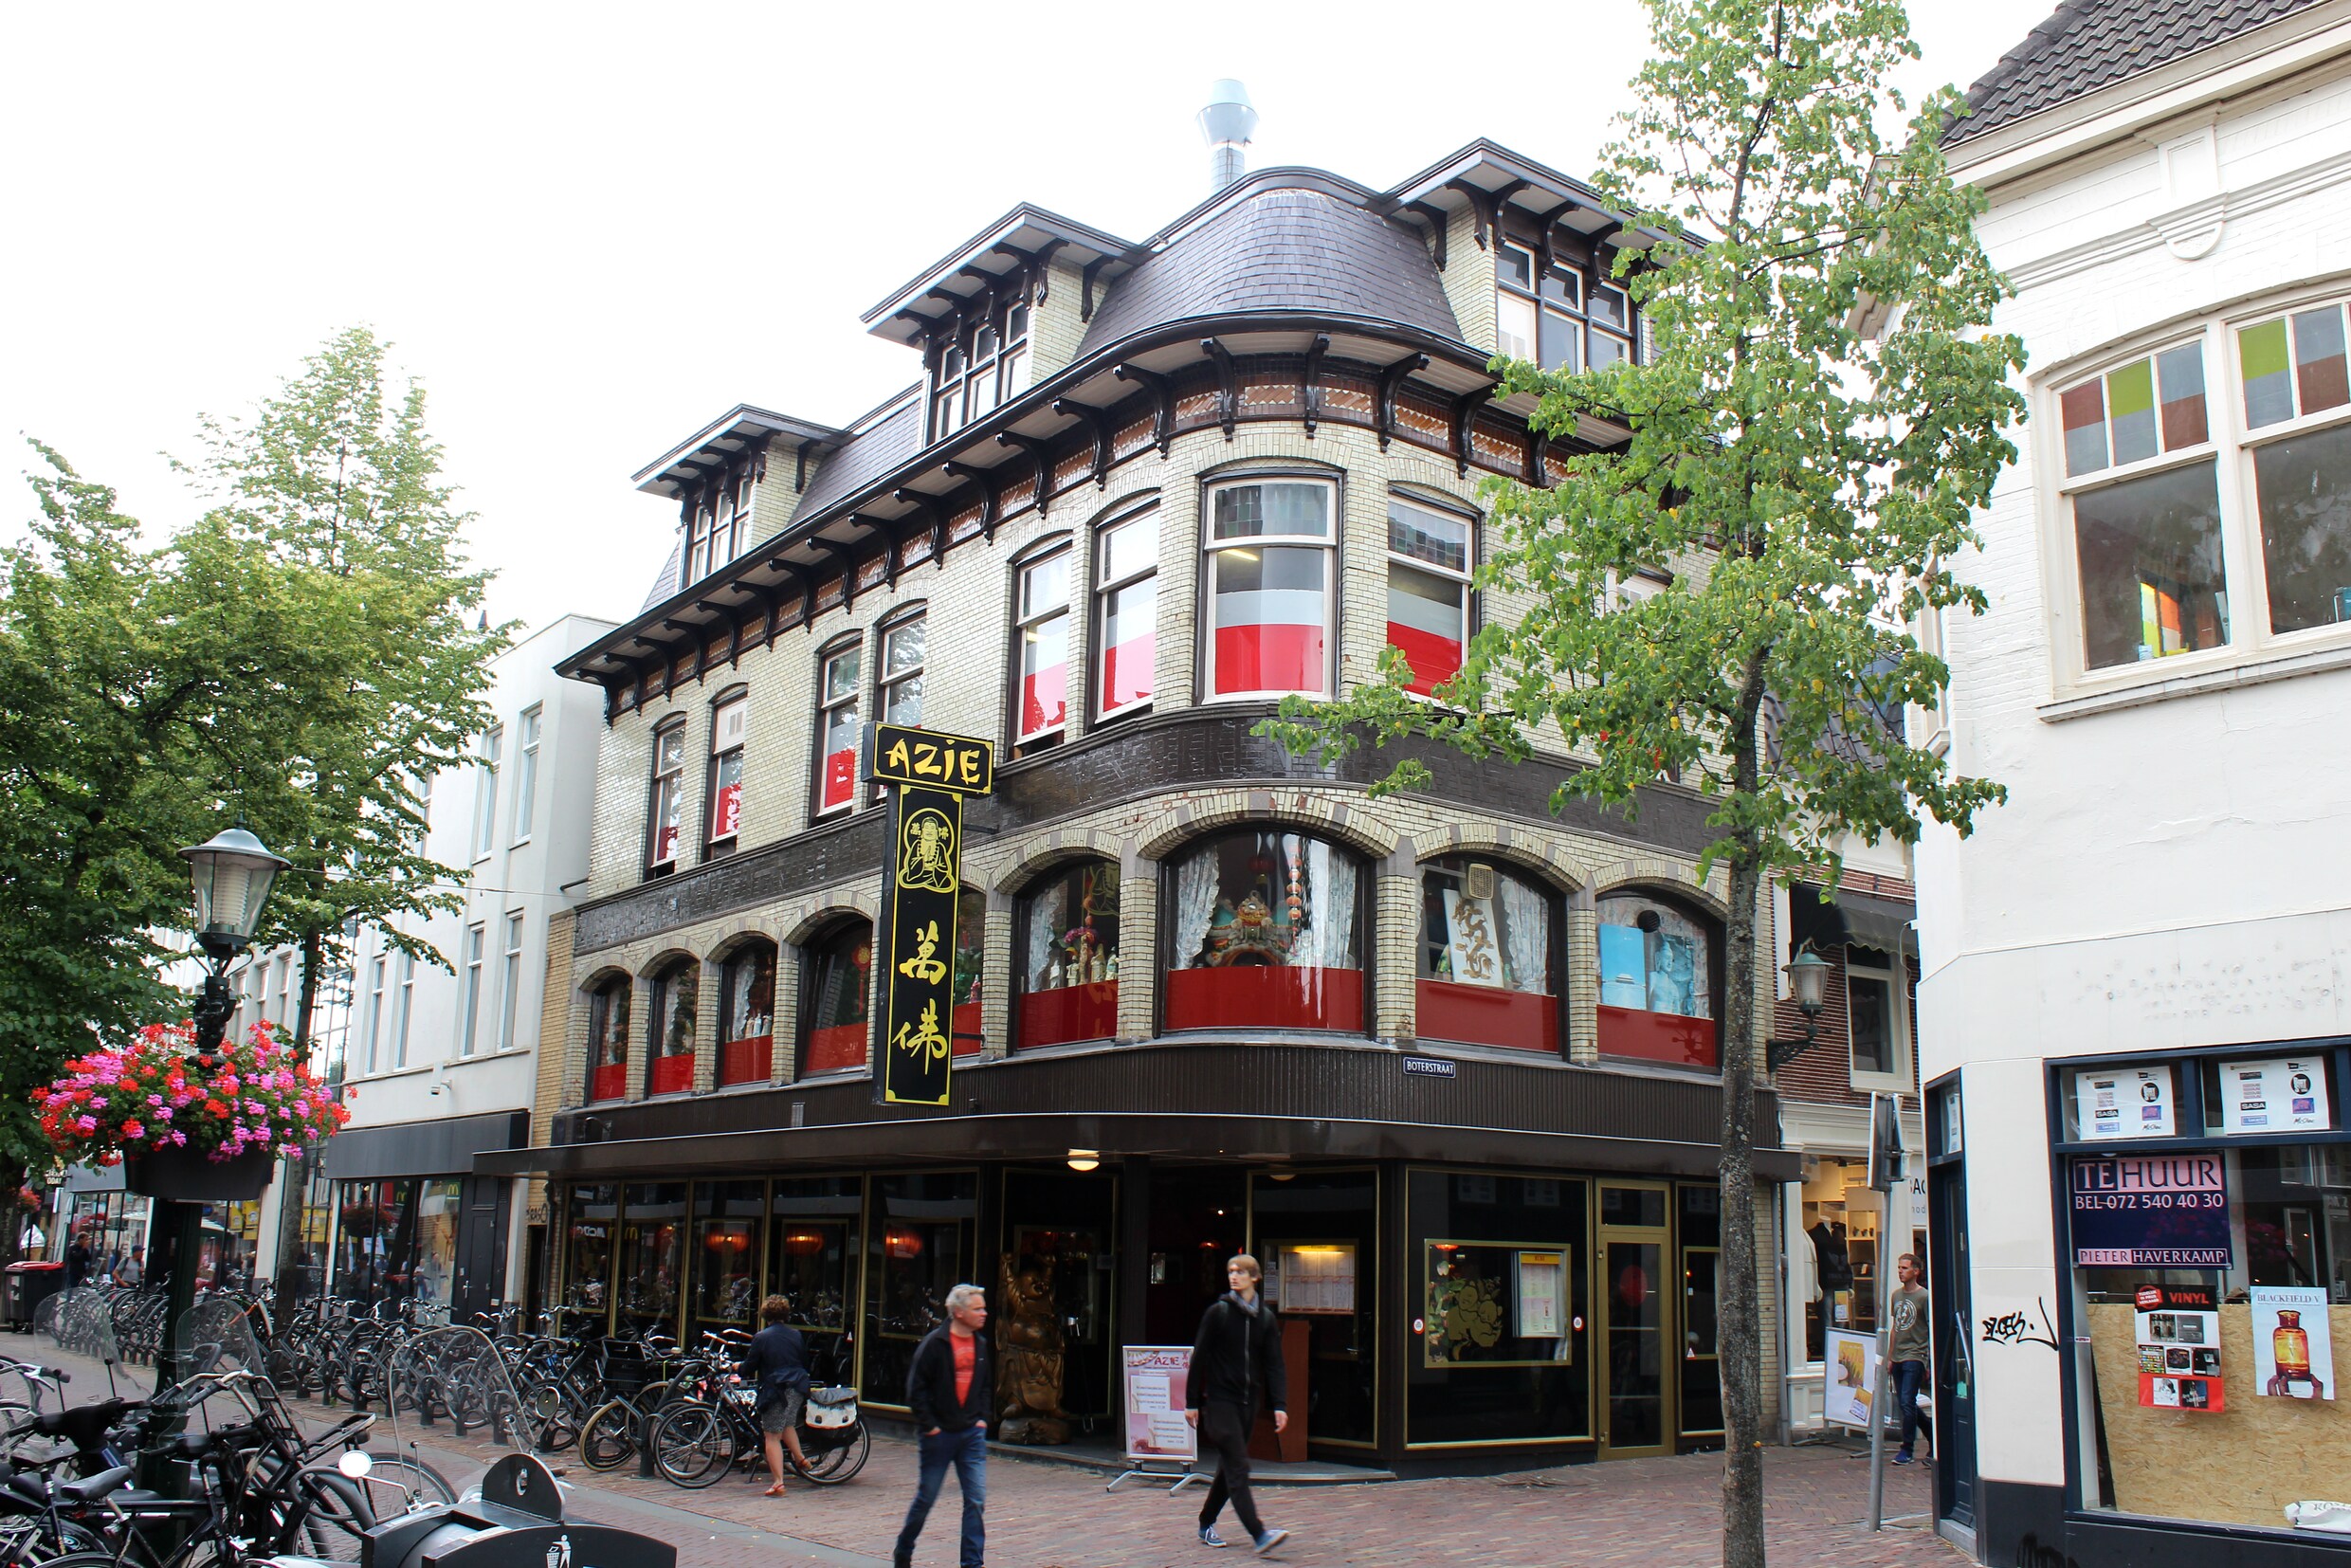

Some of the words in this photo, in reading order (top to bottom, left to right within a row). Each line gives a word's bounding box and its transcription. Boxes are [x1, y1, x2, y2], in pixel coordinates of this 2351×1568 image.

[884, 738, 980, 784] AZIE
[1407, 1061, 1454, 1074] BOTERSTRAAT
[2077, 1162, 2115, 1190] TE
[2121, 1158, 2219, 1188] HUUR
[2075, 1195, 2103, 1210] BEL
[2106, 1194, 2137, 1210] 072
[2141, 1194, 2172, 1209] 540
[2177, 1194, 2197, 1208] 40
[2202, 1193, 2223, 1208] 30
[2080, 1250, 2128, 1263] PIETER
[2133, 1250, 2225, 1263] HAVERKAMP
[2169, 1291, 2210, 1304] VINYL
[2257, 1294, 2312, 1304] BLACKFIELD
[1154, 1356, 1179, 1366] AZIE
